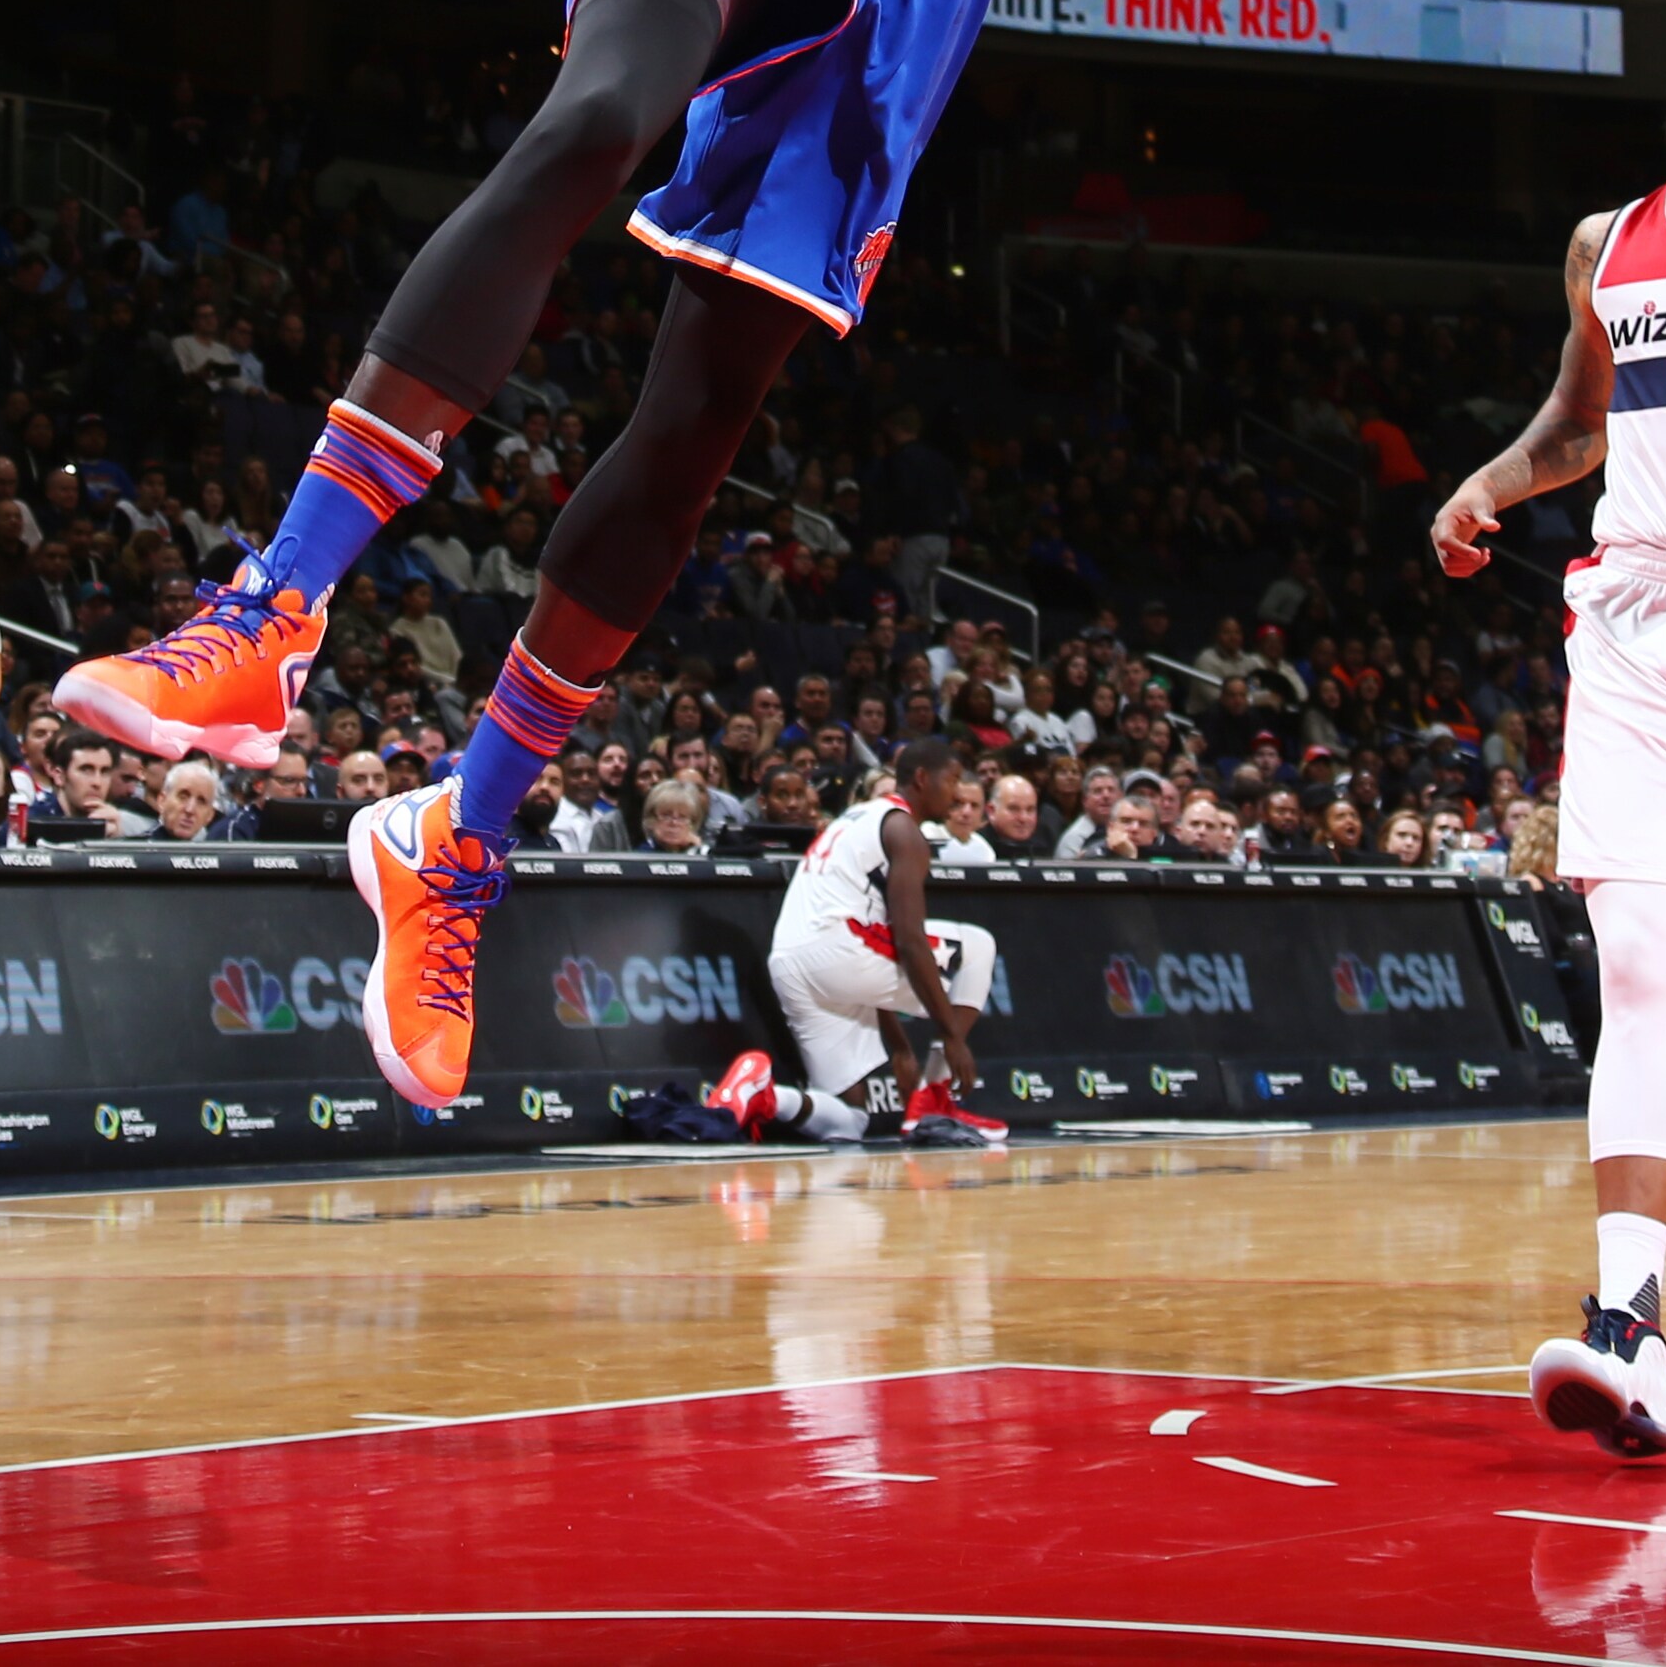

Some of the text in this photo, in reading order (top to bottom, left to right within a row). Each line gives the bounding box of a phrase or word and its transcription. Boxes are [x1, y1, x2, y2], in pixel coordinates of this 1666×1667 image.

[0, 853, 53, 868] WGL.COM
[88, 854, 137, 869] #ASKWGL
[170, 855, 220, 870] WGL.COM
[253, 856, 299, 870] #ASKWGL
[512, 861, 556, 875] WGL.COM
[1155, 952, 1253, 1015] CSN
[1378, 950, 1466, 1010] CSN
[621, 954, 743, 1024] CSN
[119, 1107, 145, 1122] WGL
[224, 1103, 247, 1118] WGL
[122, 1122, 157, 1138] Energy
[226, 1117, 276, 1132] Midstream
